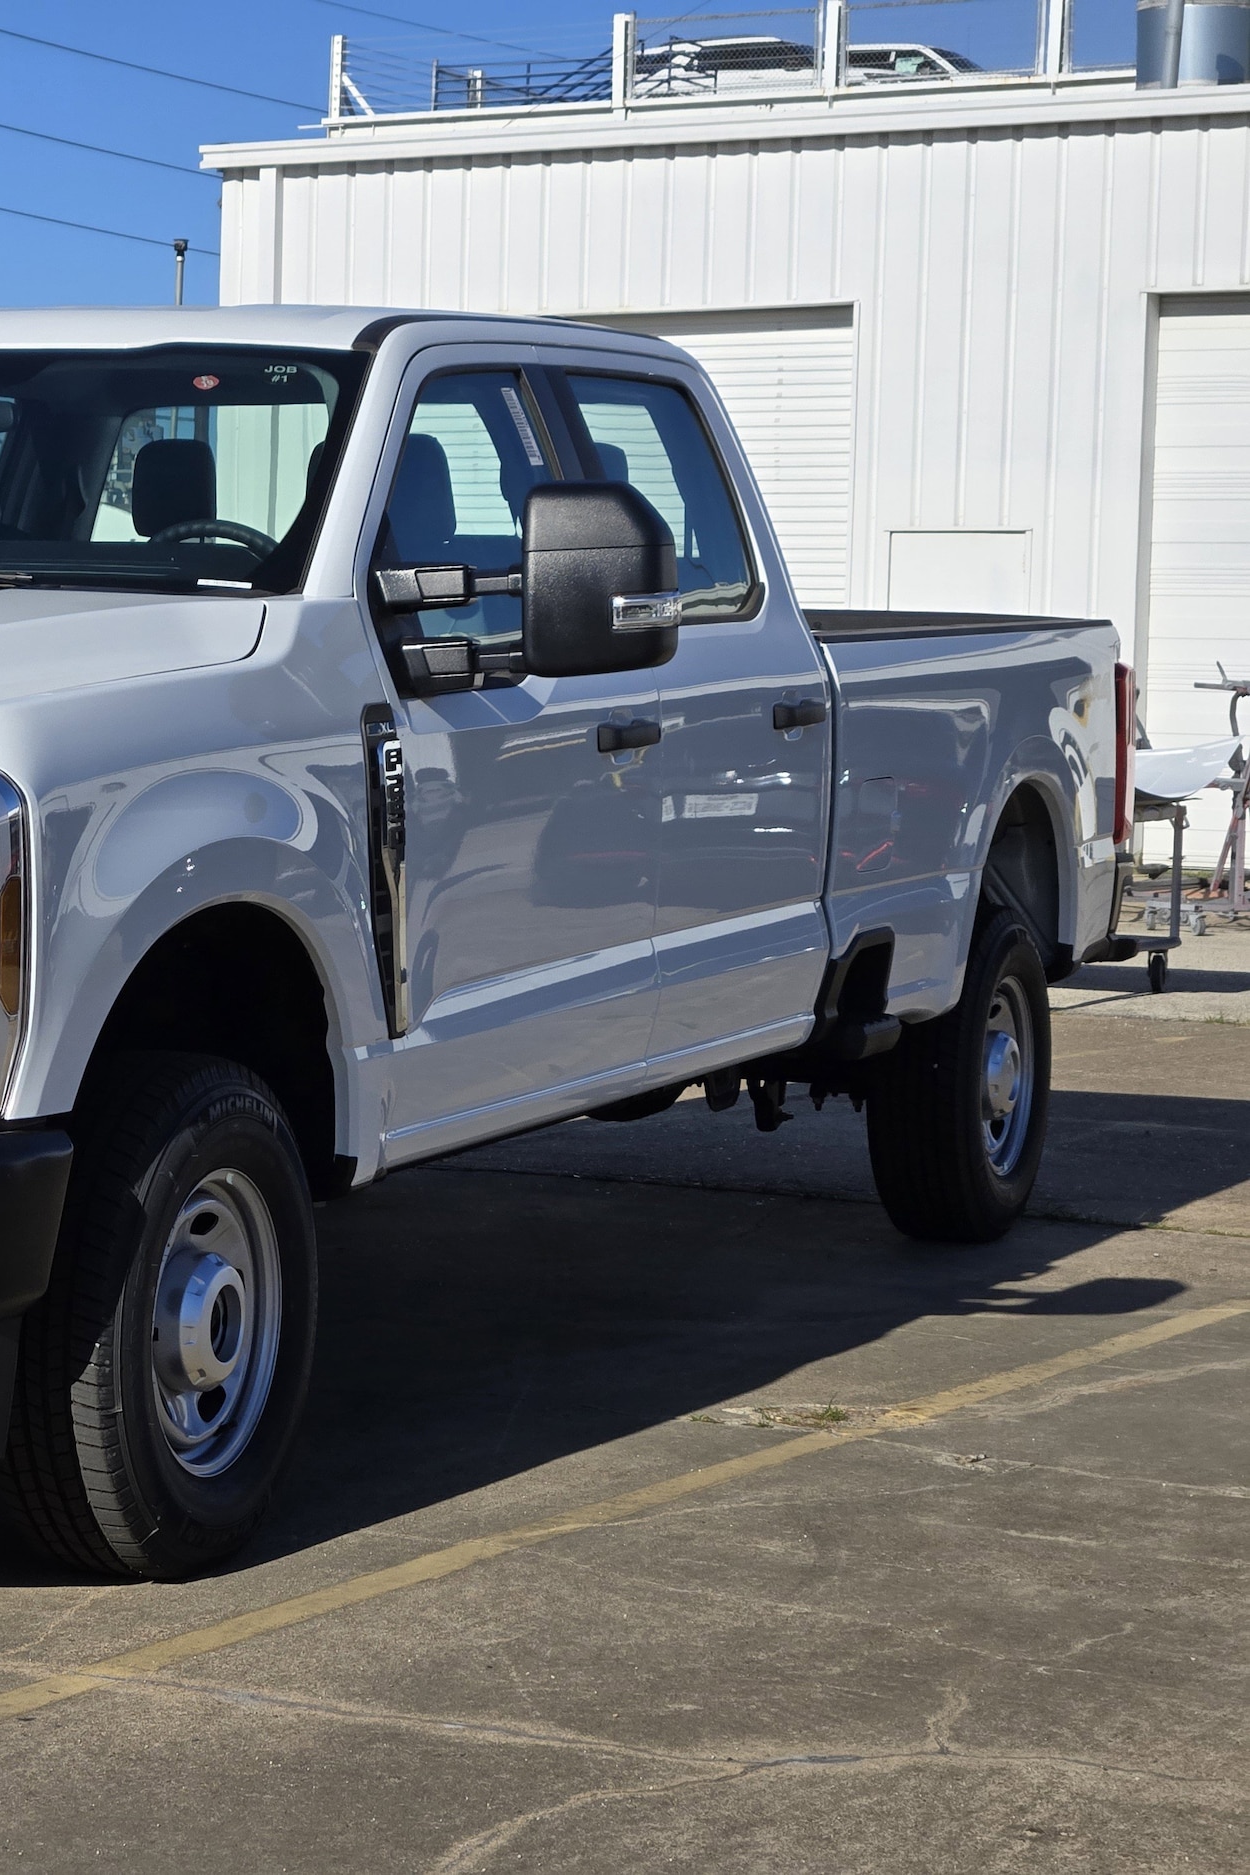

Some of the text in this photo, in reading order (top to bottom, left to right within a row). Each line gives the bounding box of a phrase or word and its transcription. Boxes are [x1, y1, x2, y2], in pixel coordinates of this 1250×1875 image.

[264, 365, 298, 374] JOB
[271, 375, 288, 383] #1
[379, 722, 395, 734] XL
[209, 1095, 273, 1122] MICHELIN
